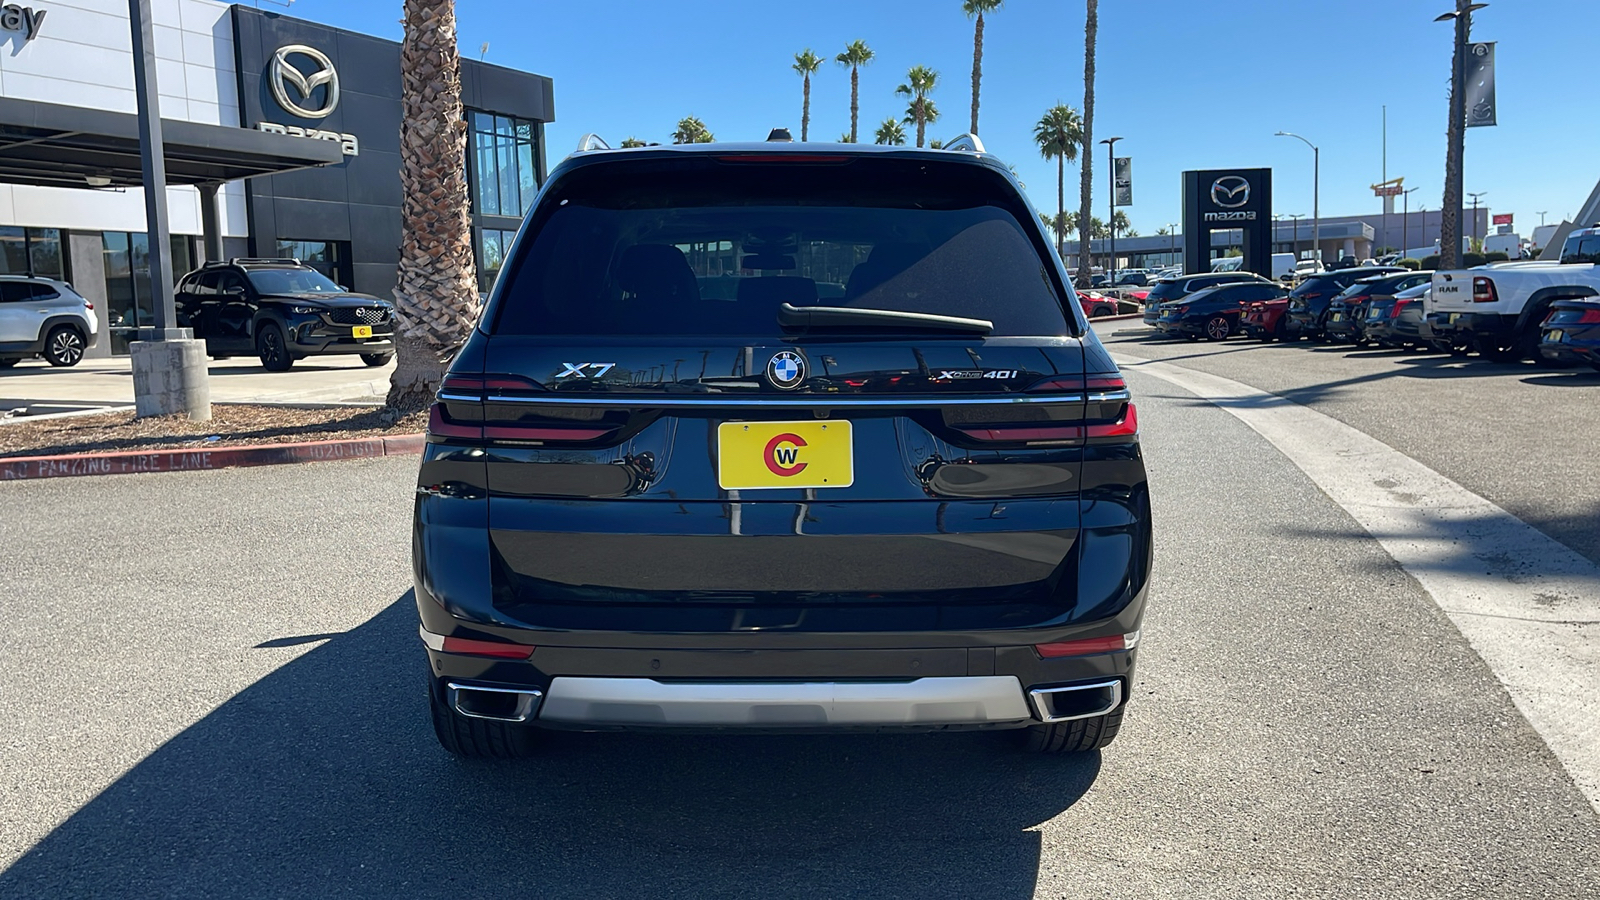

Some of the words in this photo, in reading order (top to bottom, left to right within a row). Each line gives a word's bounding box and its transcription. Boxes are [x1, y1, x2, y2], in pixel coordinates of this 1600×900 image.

[0, 3, 47, 41] ay
[1204, 211, 1257, 221] mazda
[770, 352, 803, 365] BMW
[554, 362, 616, 378] X7
[37, 457, 111, 477] PARKING
[122, 454, 161, 471] FIRE
[169, 452, 213, 470] LANE
